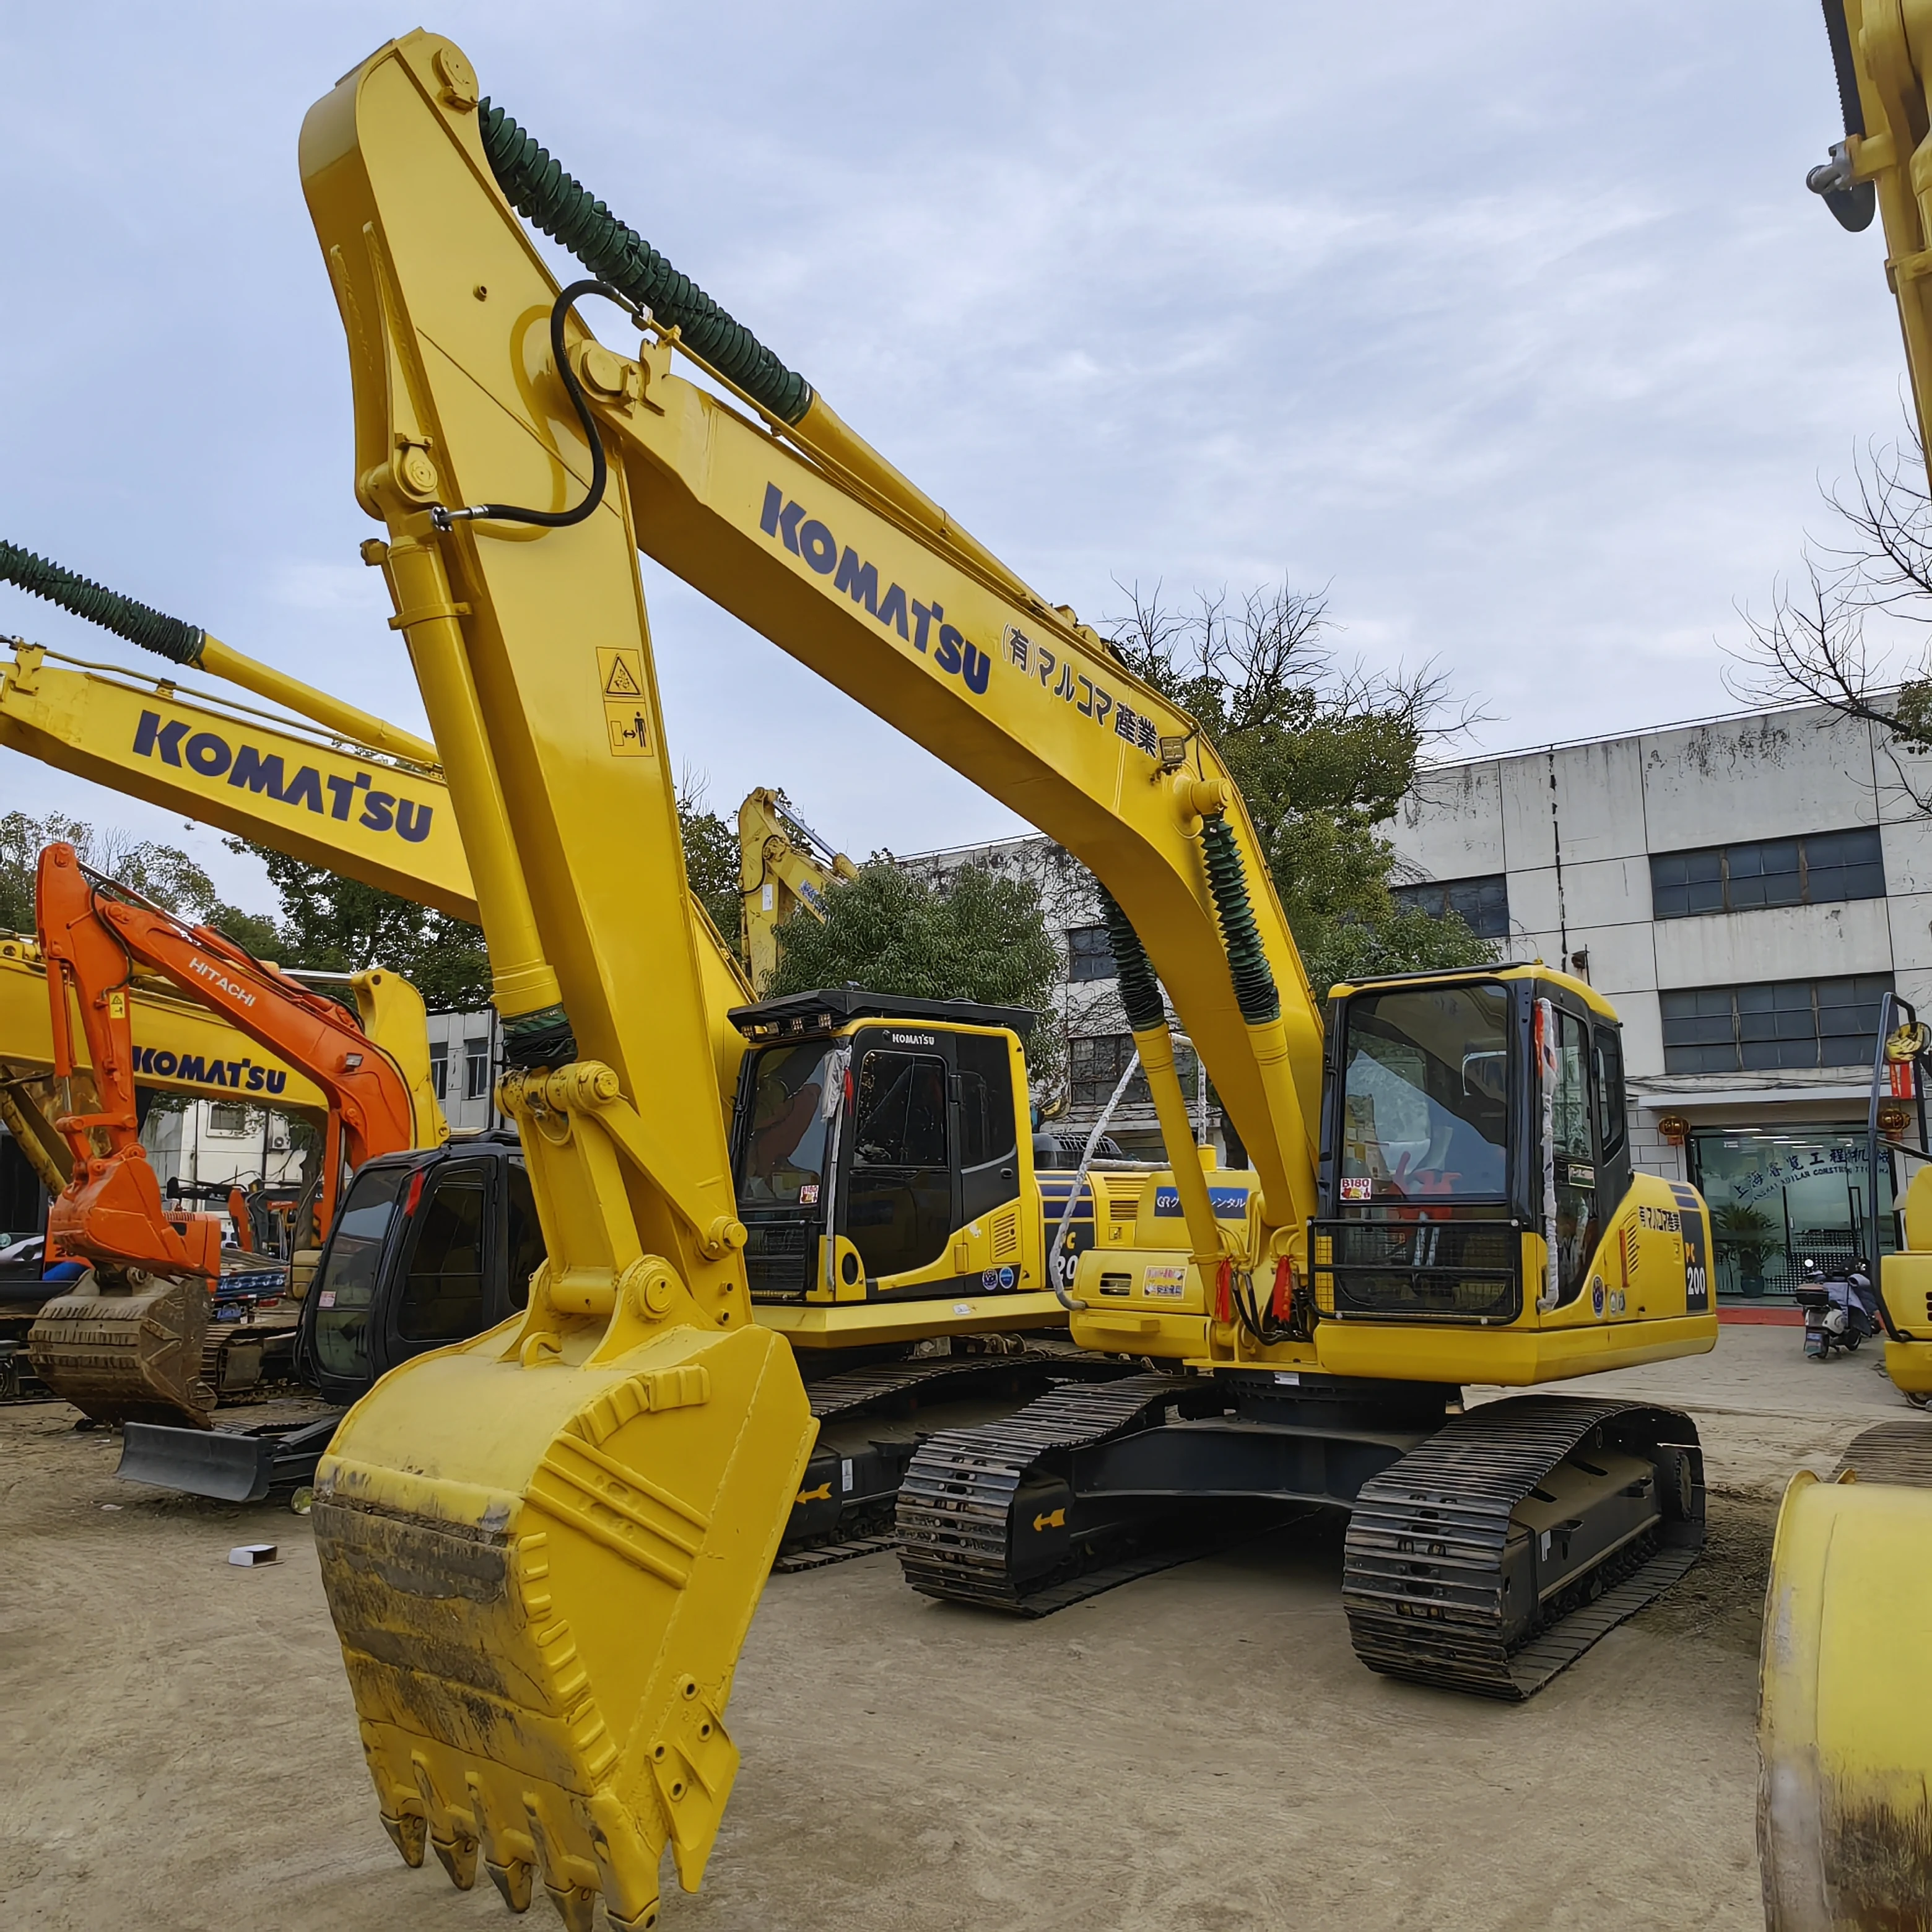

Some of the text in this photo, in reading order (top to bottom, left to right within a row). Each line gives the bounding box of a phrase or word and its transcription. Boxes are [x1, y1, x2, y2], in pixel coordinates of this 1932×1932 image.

[760, 481, 991, 695] KOMATSU
[1001, 622, 1158, 759] (有)マルコマ産業
[133, 710, 433, 842] KOMATSU
[189, 957, 256, 1006] HITACHI
[892, 1033, 934, 1045] KOMATSU
[132, 1045, 287, 1094] KOMATSU
[1342, 1179, 1369, 1187] B180
[1684, 1242, 1695, 1263] PC
[1687, 1266, 1706, 1295] 200
